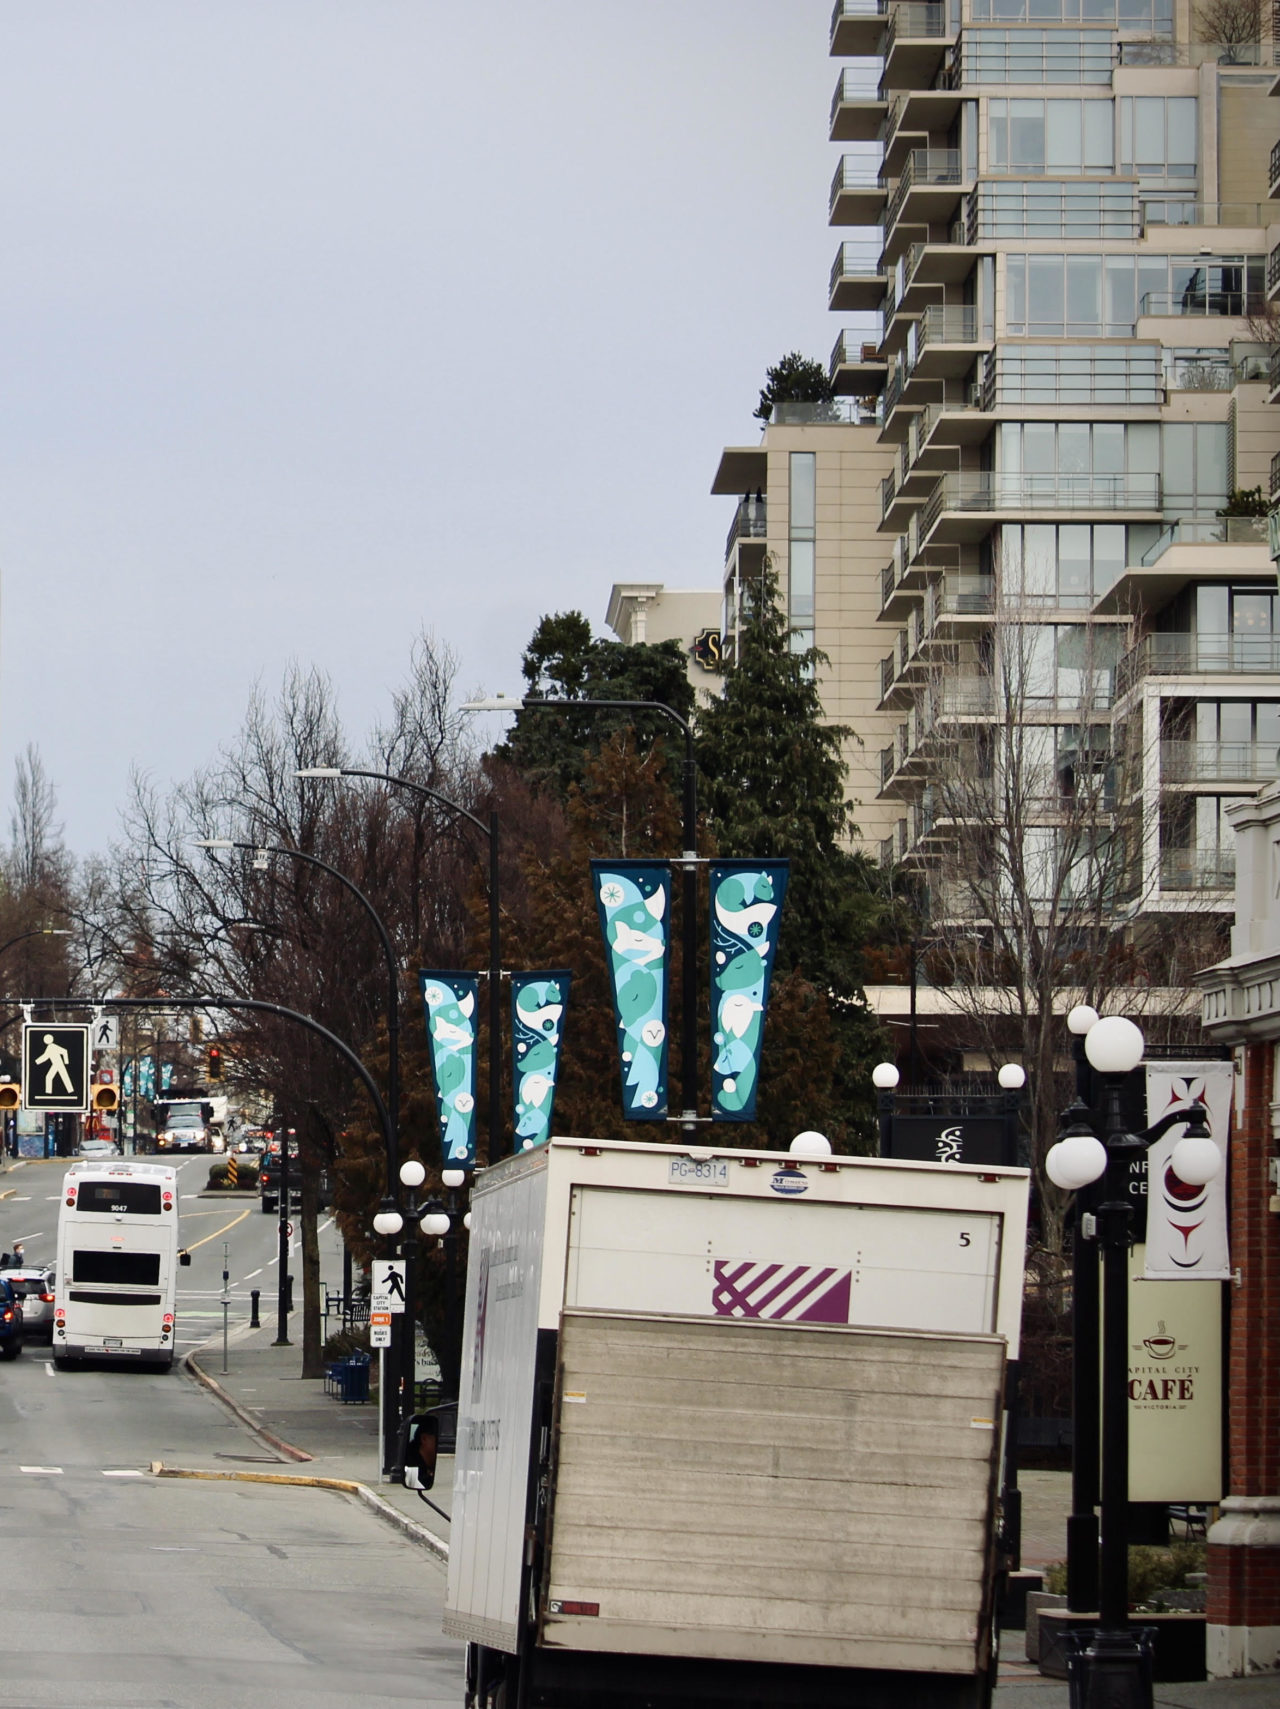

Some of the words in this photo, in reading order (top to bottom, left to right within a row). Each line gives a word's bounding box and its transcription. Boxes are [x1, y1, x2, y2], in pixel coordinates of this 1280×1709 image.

[1129, 1161, 1148, 1173] NF
[1129, 1183, 1148, 1195] CE
[958, 1232, 971, 1247] 5
[1128, 1366, 1167, 1374] APITAL
[1174, 1366, 1199, 1374] CITY
[1128, 1374, 1194, 1401] CAFÉ
